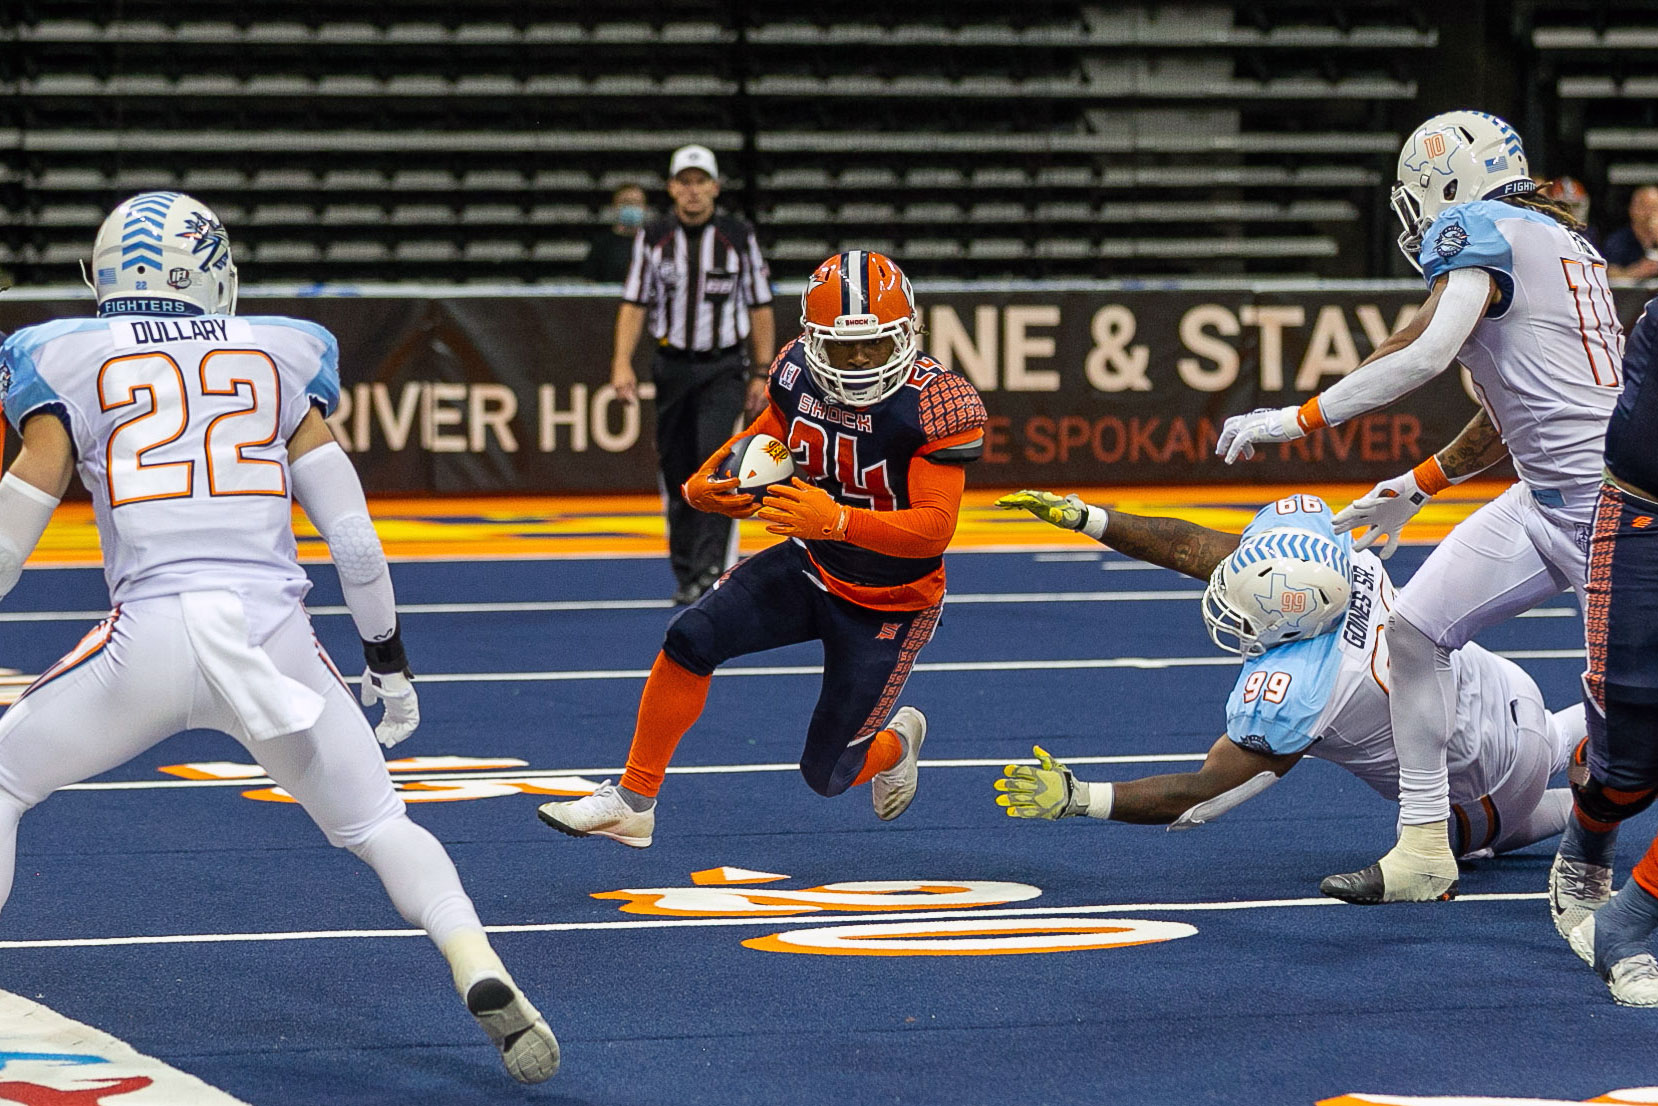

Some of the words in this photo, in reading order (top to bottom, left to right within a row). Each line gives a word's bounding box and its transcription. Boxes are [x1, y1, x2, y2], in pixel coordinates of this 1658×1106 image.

[1424, 133, 1446, 159] 10
[135, 281, 147, 290] 22
[104, 300, 186, 313] FIGHTERS
[131, 319, 228, 344] DULLARY
[1085, 304, 1153, 392] &
[98, 349, 287, 508] 22
[325, 382, 519, 452] RIVER
[798, 393, 872, 433] SHOCK
[788, 416, 897, 512] 24
[1281, 592, 1306, 612] 99
[1343, 591, 1372, 650] GOINES
[1243, 671, 1292, 704] 99
